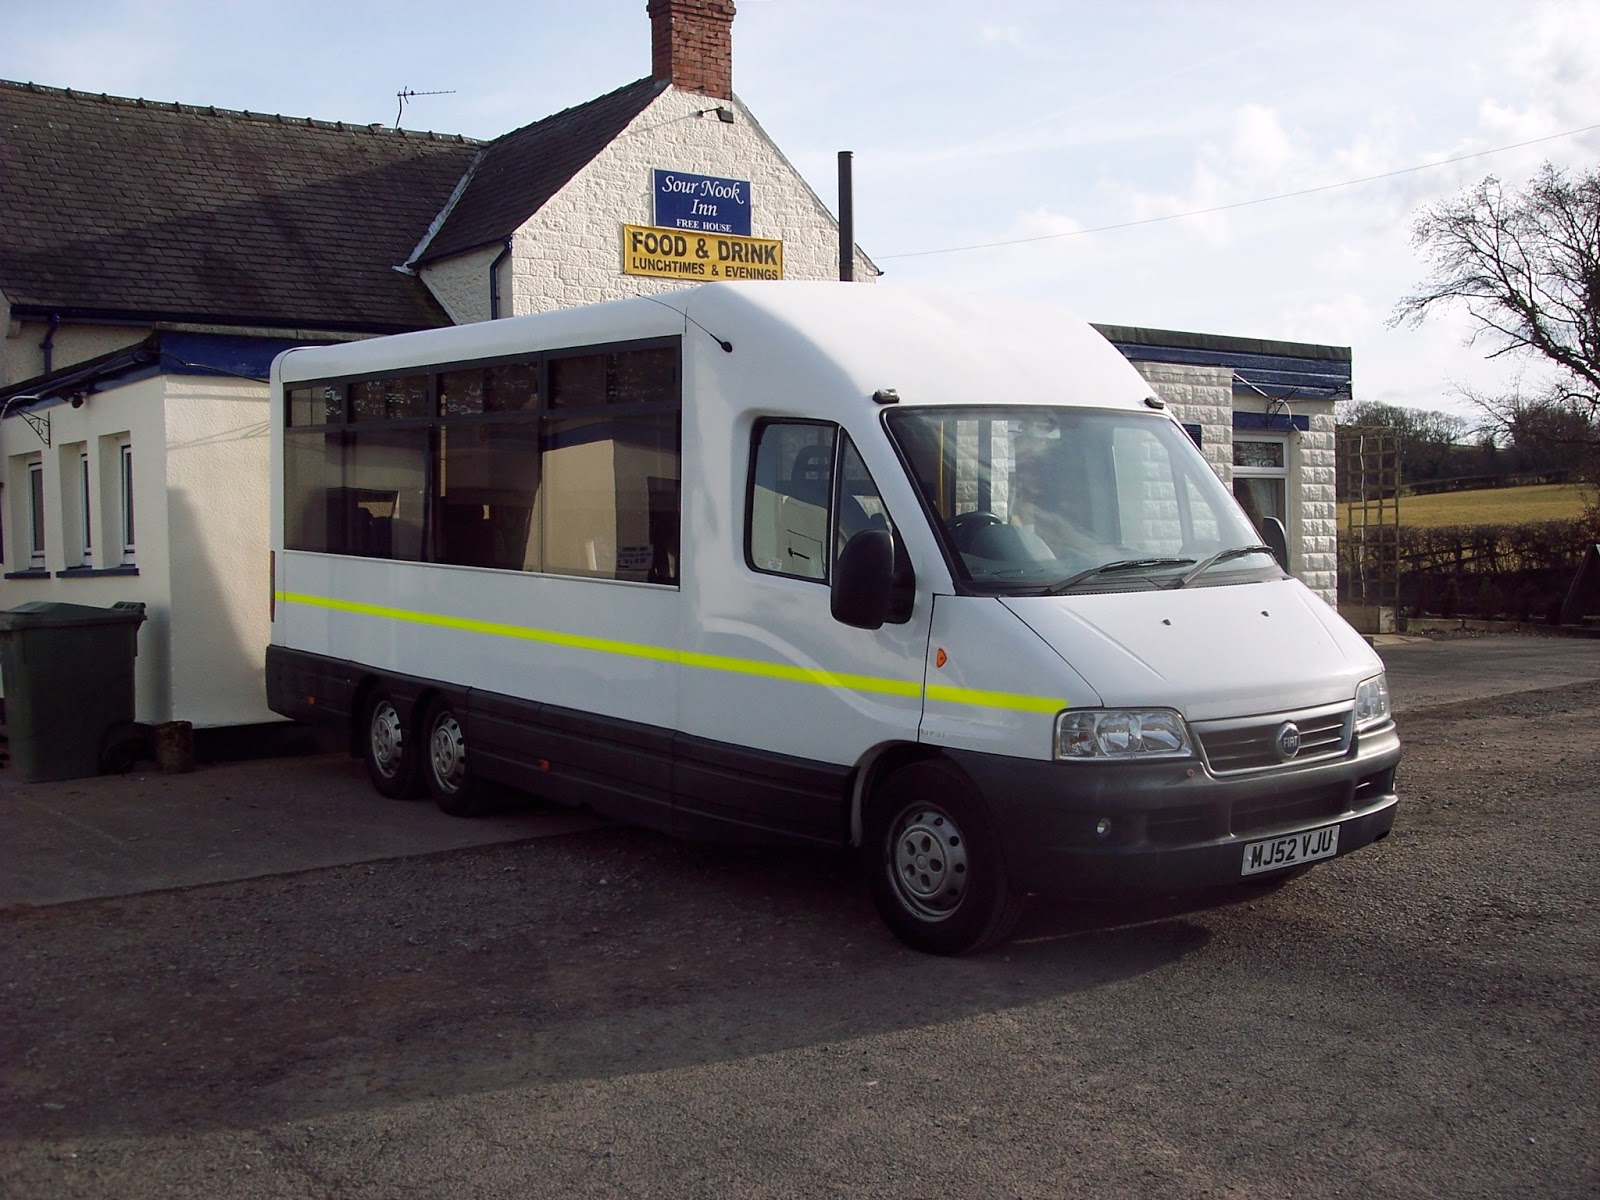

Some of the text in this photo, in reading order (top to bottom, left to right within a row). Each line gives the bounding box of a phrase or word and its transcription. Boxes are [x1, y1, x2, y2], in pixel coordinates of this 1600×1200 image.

[662, 176, 744, 205] Sour Nook
[690, 199, 718, 217] Inn
[676, 218, 732, 233] FREE HOUSE
[632, 231, 778, 265] FOOD & DRINK
[632, 257, 778, 281] LUNCHTIMES & EVENINGS
[1283, 735, 1298, 748] FIAT
[1250, 829, 1333, 869] MJ52 VJU
